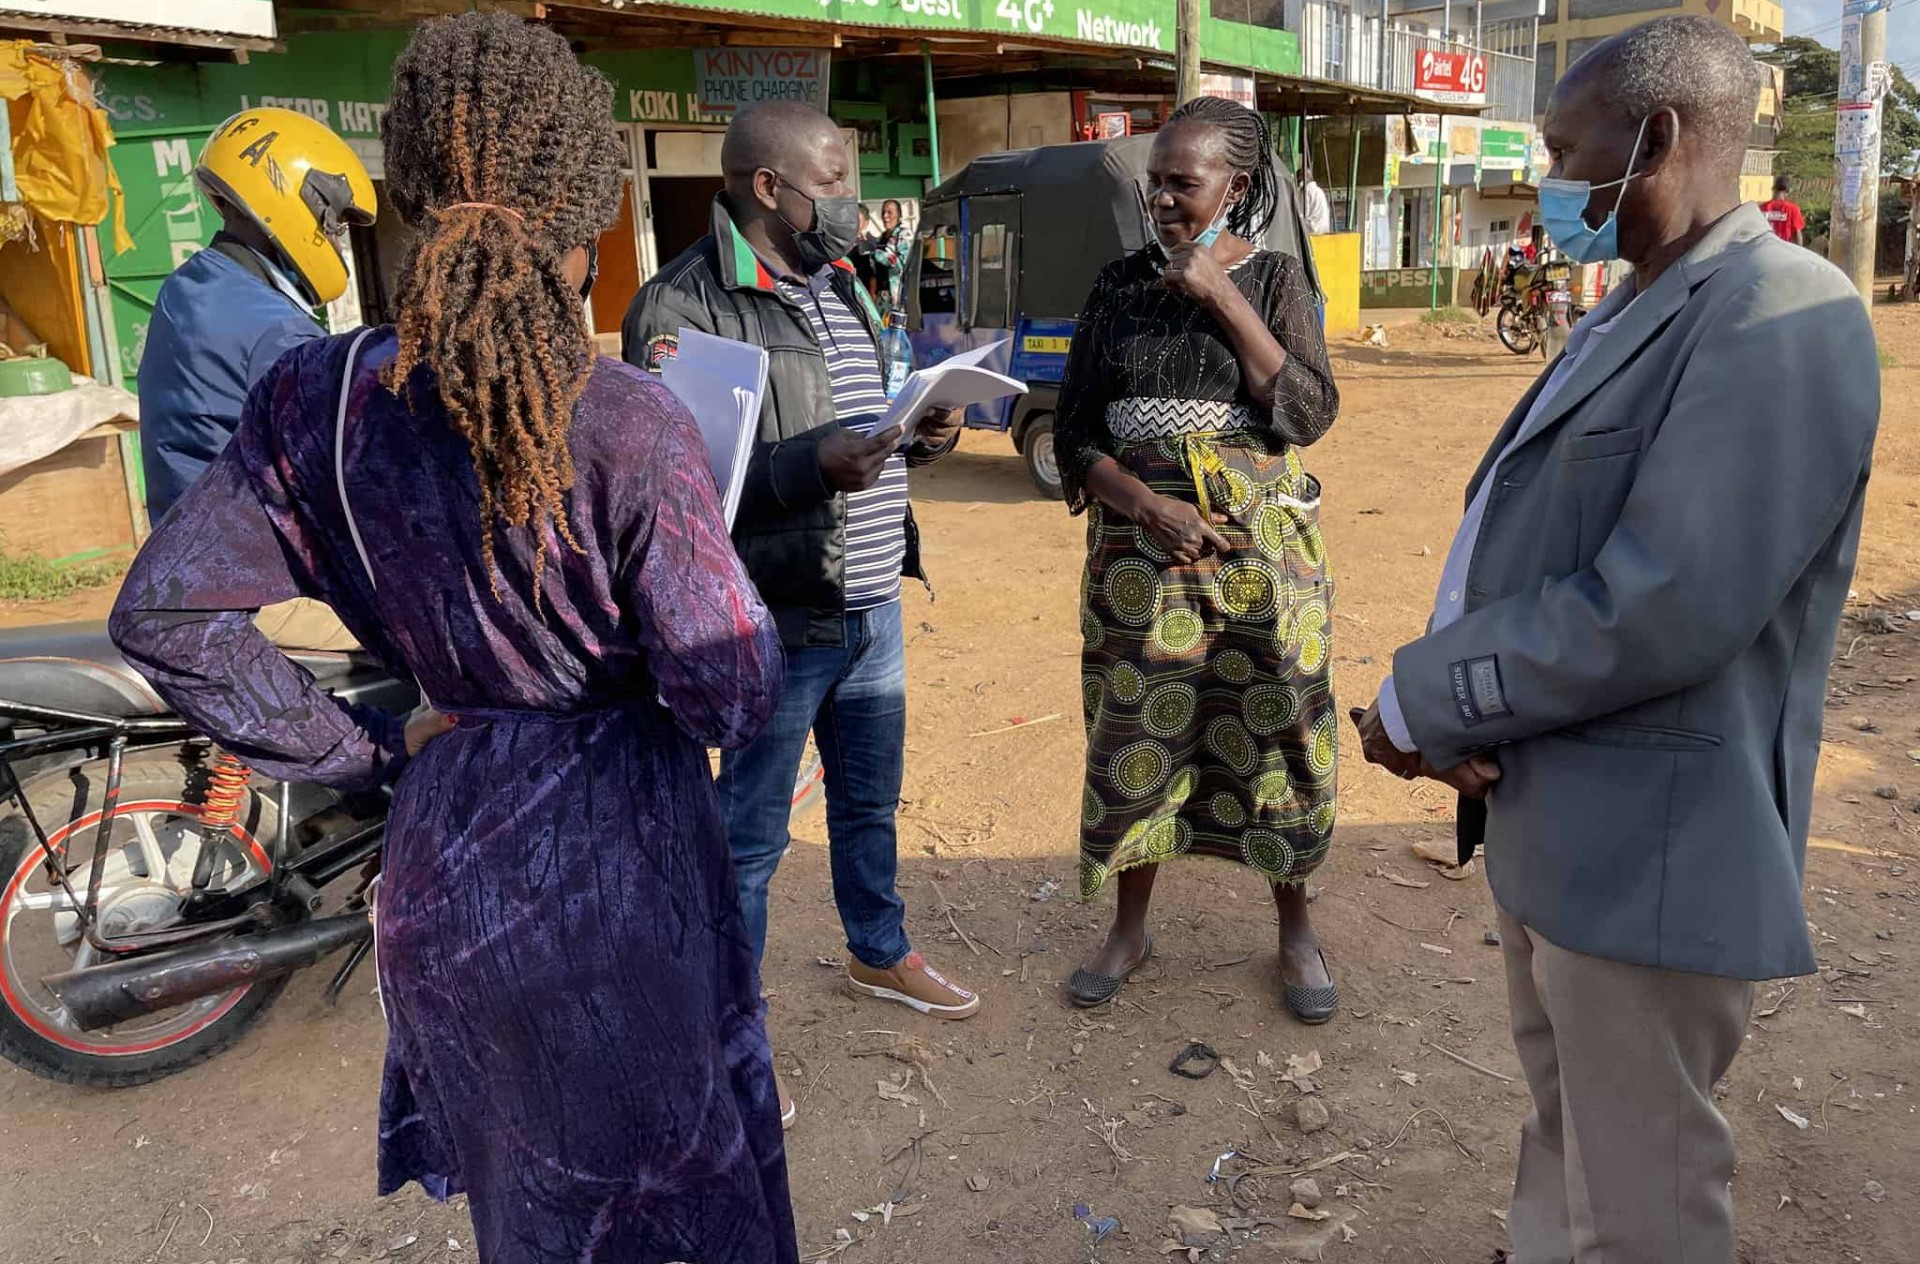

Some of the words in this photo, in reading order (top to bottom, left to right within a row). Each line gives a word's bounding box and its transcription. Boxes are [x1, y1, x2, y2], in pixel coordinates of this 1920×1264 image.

[1076, 9, 1161, 49] Network
[705, 50, 820, 78] KINYOZI
[1460, 54, 1483, 92] 4G
[630, 89, 679, 120] KOKI
[704, 80, 748, 101] PHONE
[752, 81, 818, 101] CHARGING
[1027, 338, 1044, 350] TAXI
[1454, 666, 1466, 701] SUPER
